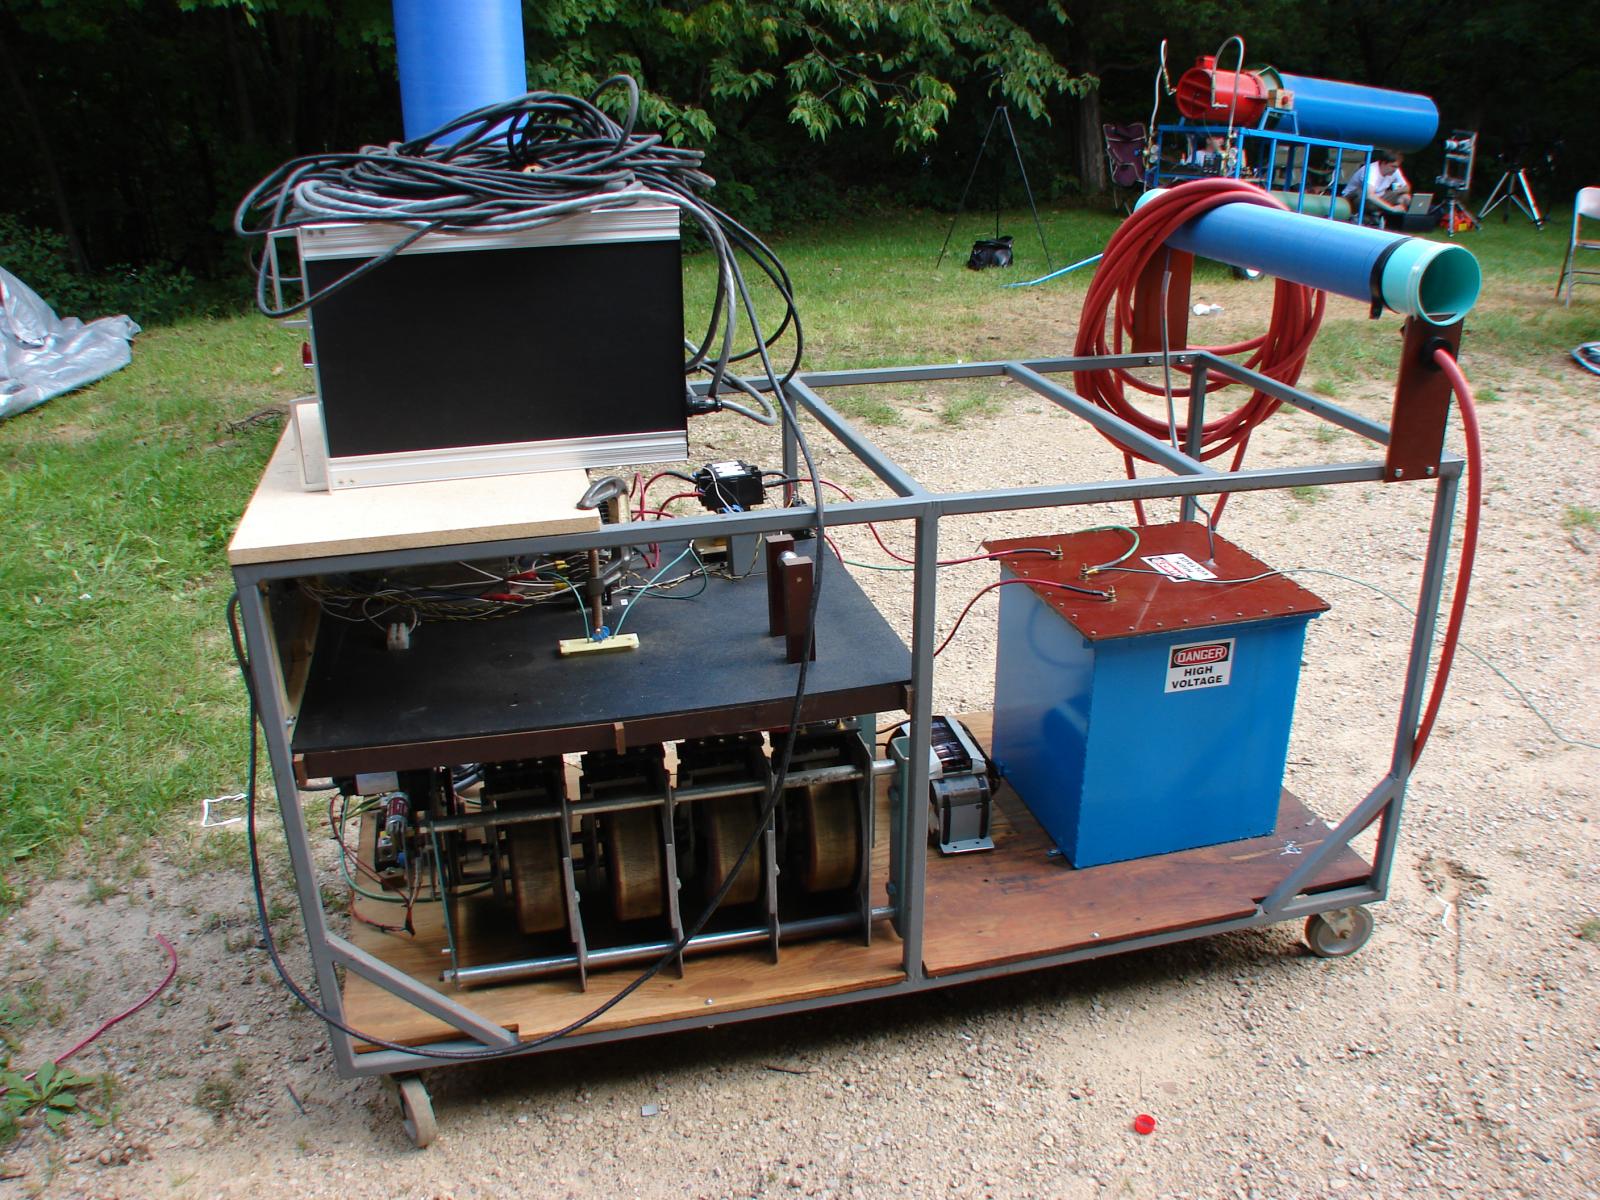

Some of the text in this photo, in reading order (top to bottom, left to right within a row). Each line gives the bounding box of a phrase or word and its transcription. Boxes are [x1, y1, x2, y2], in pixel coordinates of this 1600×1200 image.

[1177, 647, 1224, 663] DANGER
[1184, 665, 1213, 676] HIGH
[1172, 675, 1223, 689] VOLTAGE
